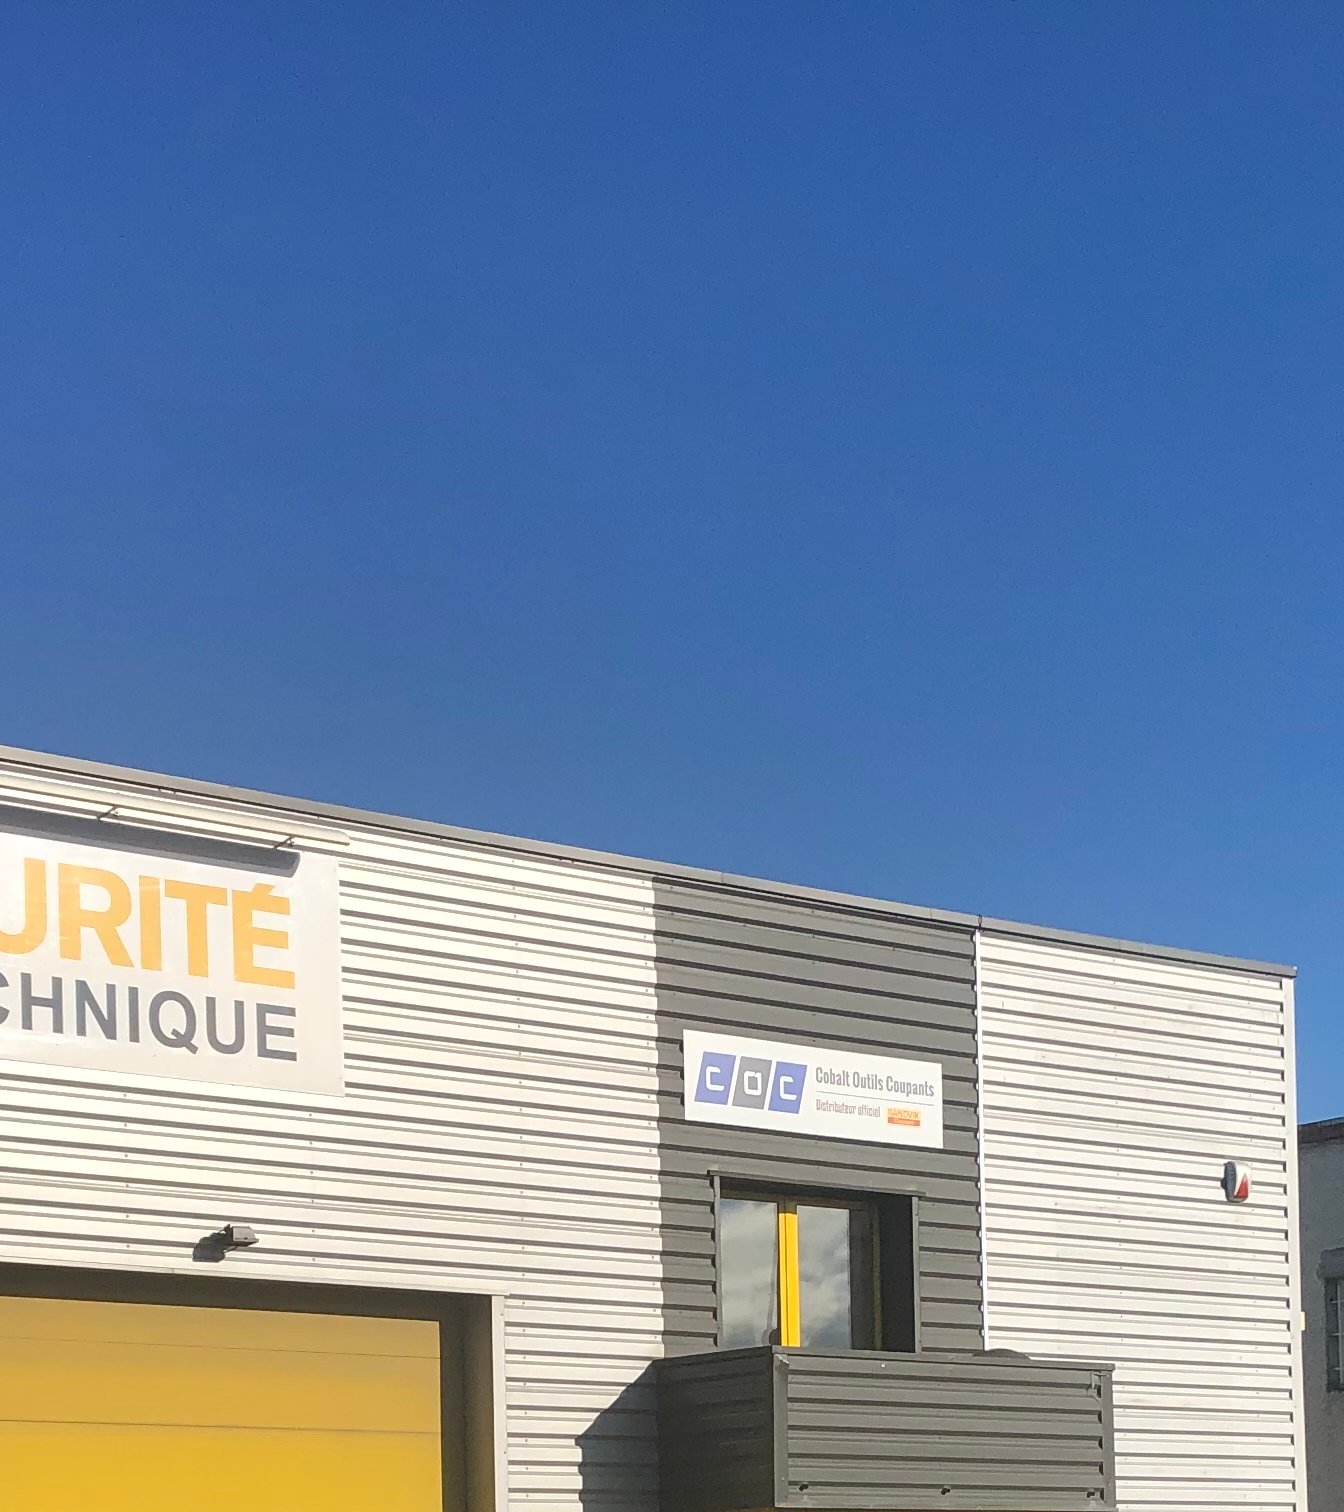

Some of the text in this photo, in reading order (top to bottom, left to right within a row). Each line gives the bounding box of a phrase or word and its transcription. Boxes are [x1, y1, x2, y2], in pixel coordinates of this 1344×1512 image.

[816, 1067, 935, 1097] Cobalt Outils Coupants
[816, 1099, 856, 1115] Distributeur
